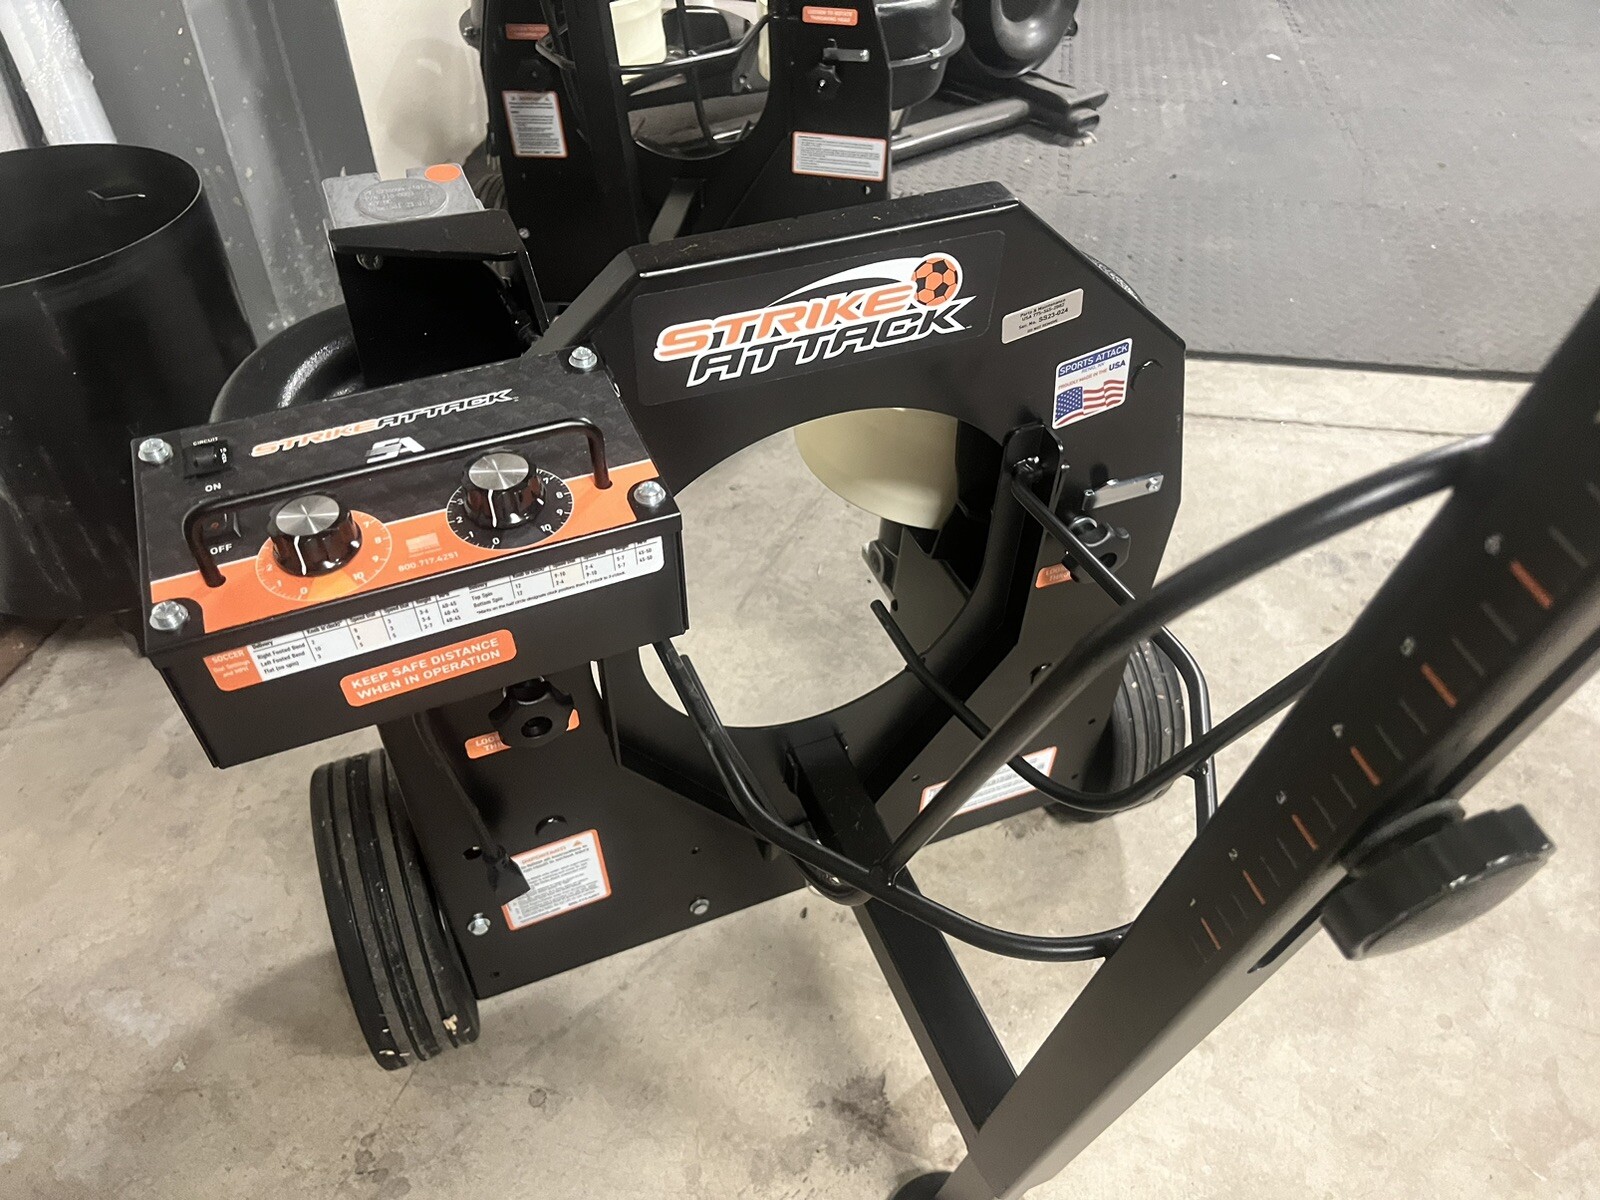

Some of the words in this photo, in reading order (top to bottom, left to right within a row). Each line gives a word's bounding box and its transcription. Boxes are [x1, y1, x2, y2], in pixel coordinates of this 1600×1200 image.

[654, 282, 917, 361] STRIKE
[686, 296, 977, 388] ATTACK
[1059, 357, 1094, 375] SPORTS
[1095, 344, 1128, 362] ATTACK
[1108, 360, 1126, 371] USA
[192, 437, 218, 446] CIRCUIT
[205, 483, 221, 492] ON
[556, 491, 564, 499] 8
[540, 523, 552, 532] 10
[492, 537, 500, 545] 0
[210, 543, 232, 555] OFF
[266, 564, 273, 572] 2
[353, 571, 365, 580] 10
[300, 587, 308, 595] 0
[211, 649, 245, 664] SOCCER
[351, 671, 389, 689] KEEP
[391, 659, 428, 677] SAFE
[431, 637, 500, 665] DISTANCE
[356, 680, 402, 700] WHEN
[404, 673, 421, 686] IN
[423, 649, 501, 680] OPERATION
